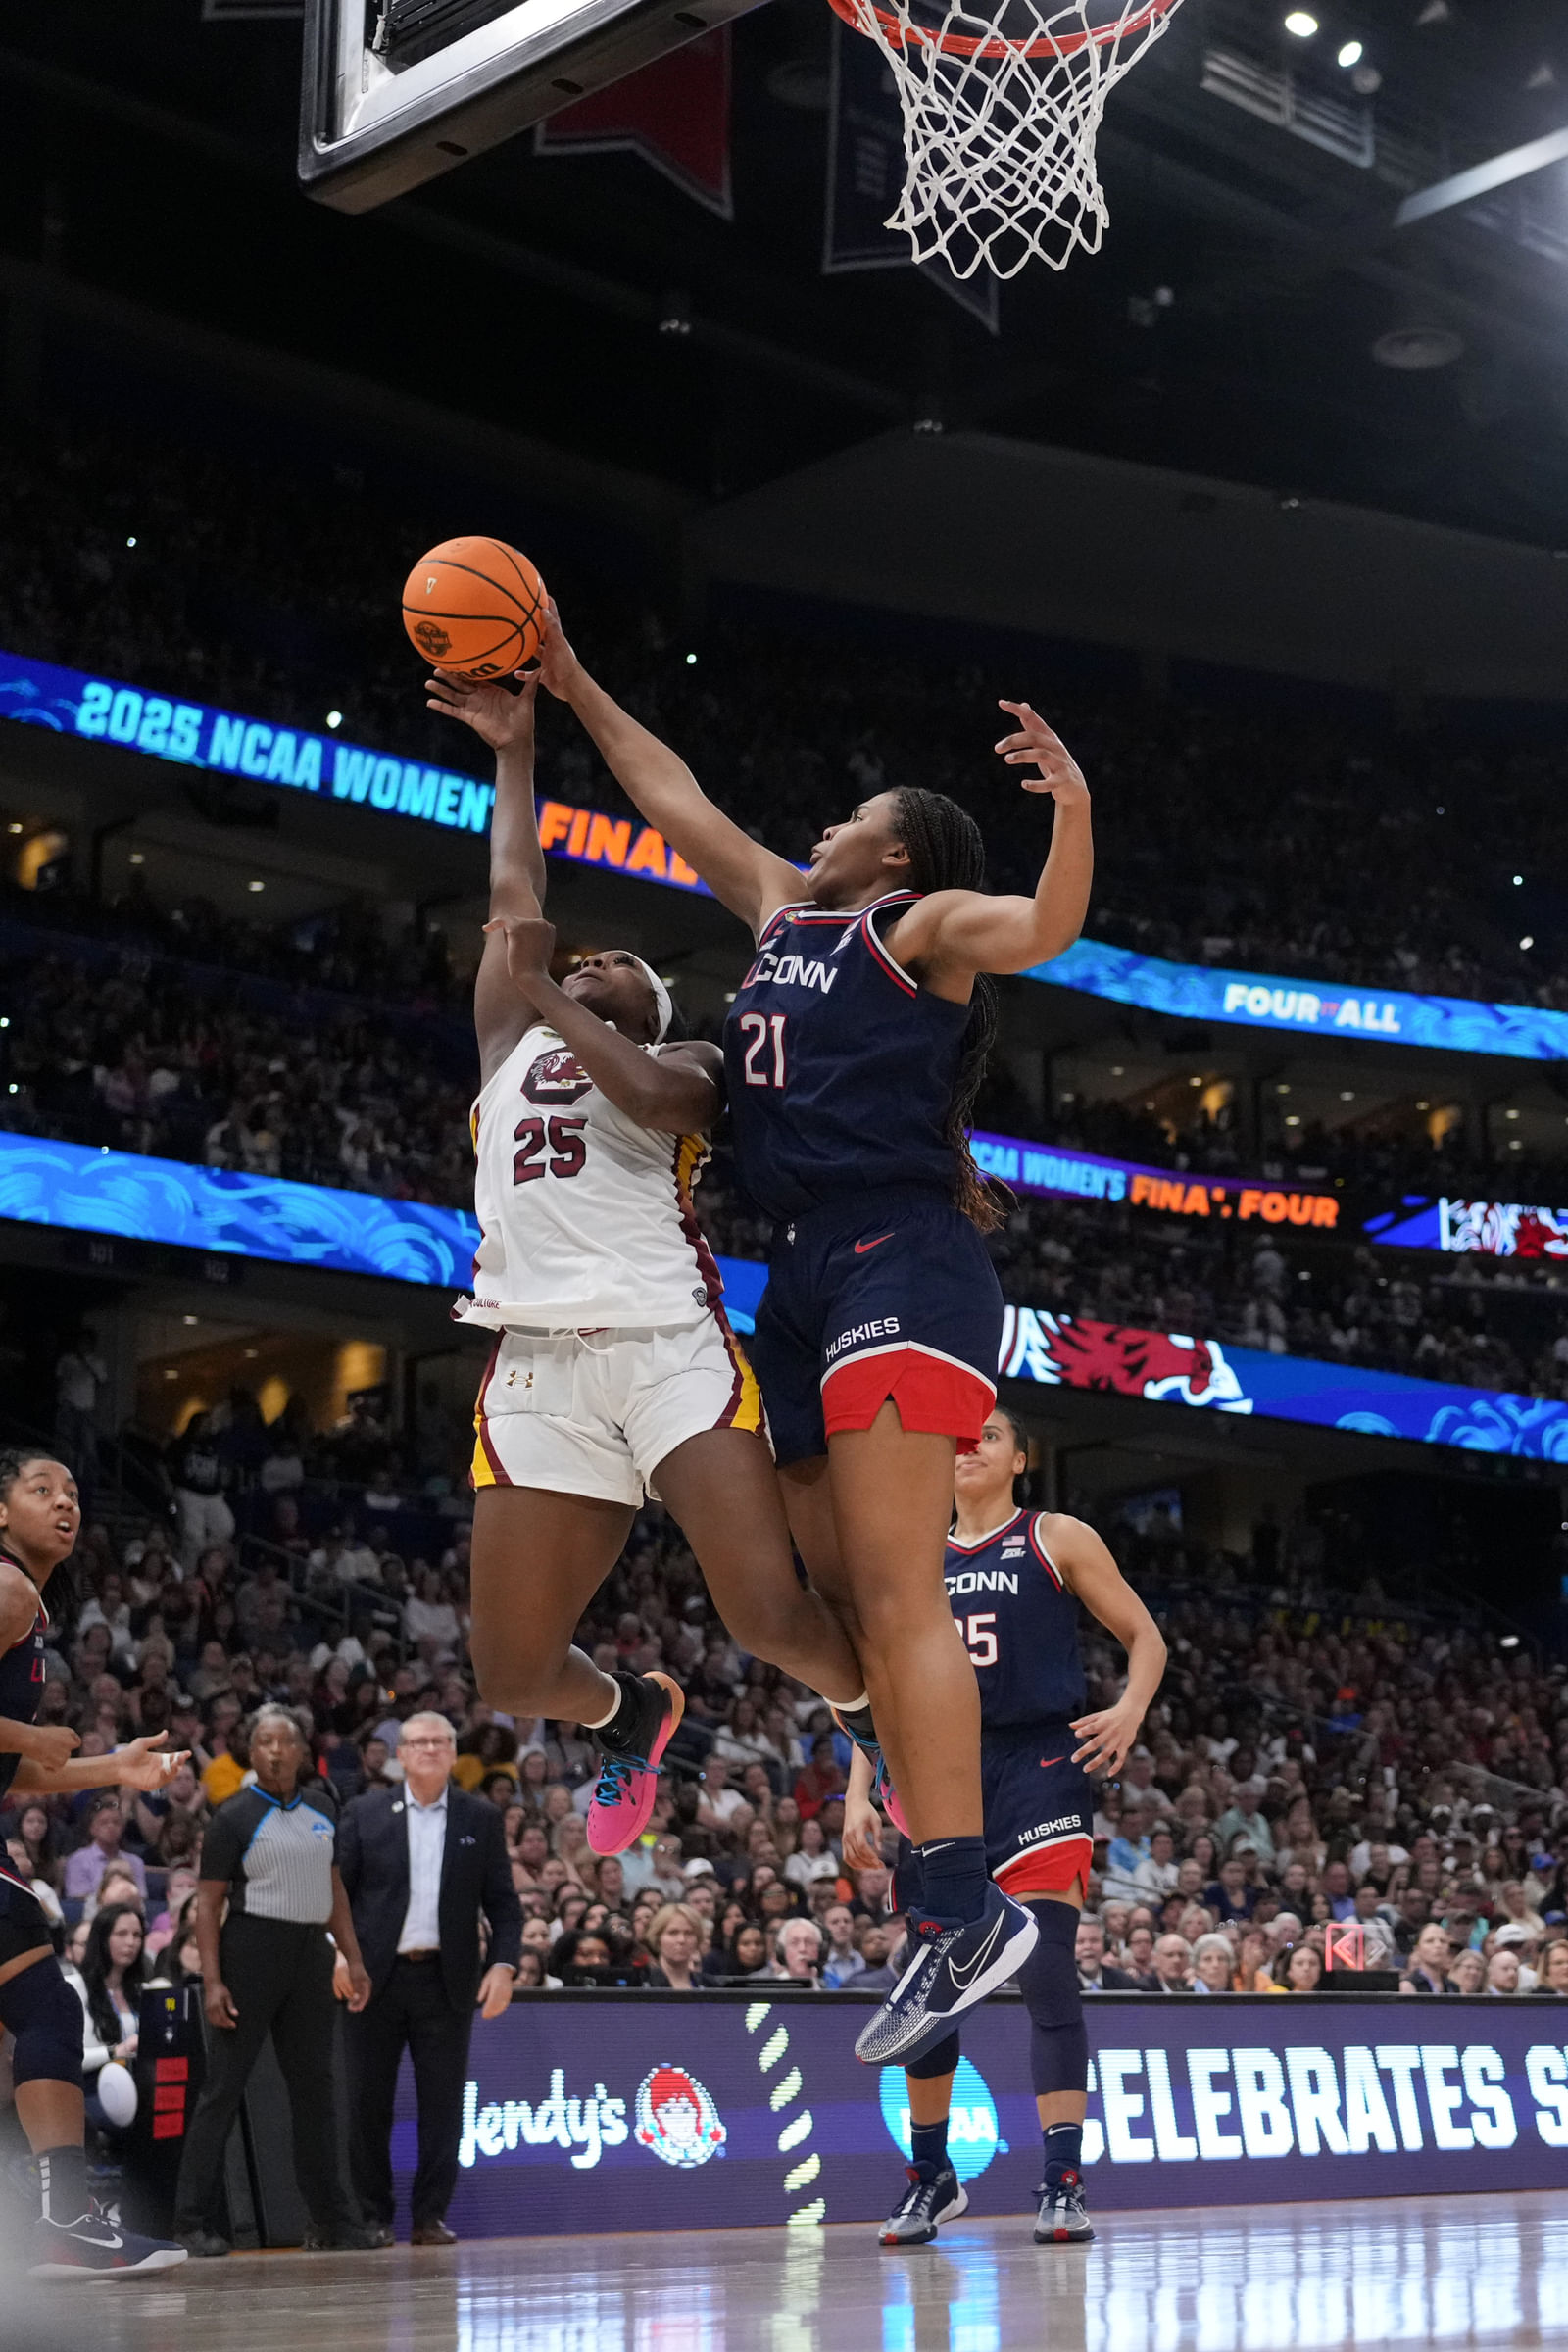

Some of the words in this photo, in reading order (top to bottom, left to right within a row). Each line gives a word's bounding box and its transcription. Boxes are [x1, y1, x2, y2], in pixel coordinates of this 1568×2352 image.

[75, 681, 204, 759] 2025
[207, 714, 323, 792] NCAA
[332, 745, 497, 833] WOMEN'
[1224, 982, 1321, 1024] FOUR
[1333, 999, 1401, 1034] ALL
[740, 1011, 788, 1089] 21
[514, 1115, 589, 1186] 25
[969, 1139, 1019, 1181] CAA
[1022, 1150, 1127, 1201] WOMEN'S
[1237, 1189, 1340, 1229] FOUR
[825, 1316, 901, 1363] HUSKIES
[944, 1571, 1019, 1596] CONN
[1017, 1814, 1082, 1846] HUSKIES
[1525, 2045, 1568, 2148] S
